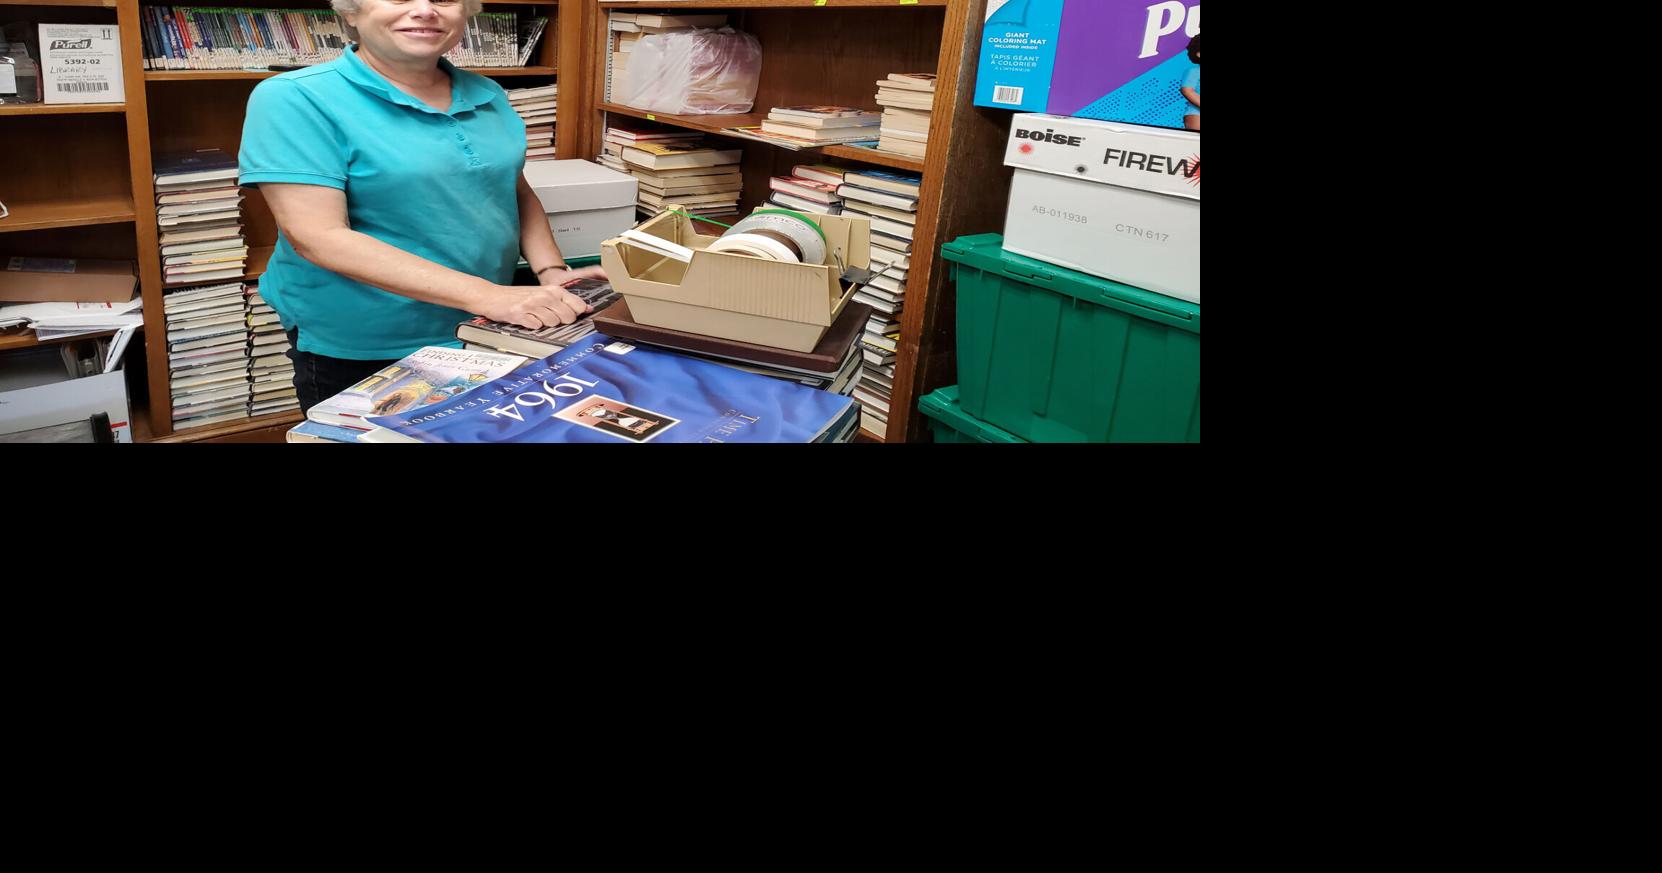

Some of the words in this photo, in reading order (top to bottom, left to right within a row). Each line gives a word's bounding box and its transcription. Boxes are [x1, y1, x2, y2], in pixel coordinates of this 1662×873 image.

[53, 40, 90, 49] Purell
[1031, 204, 1088, 225] AB-011938
[1115, 223, 1144, 238] CTN
[1146, 230, 1170, 243] 617
[494, 342, 606, 397] COMMEMORATIVE
[482, 370, 600, 423] 1964
[403, 396, 492, 427] YEARBOOK
